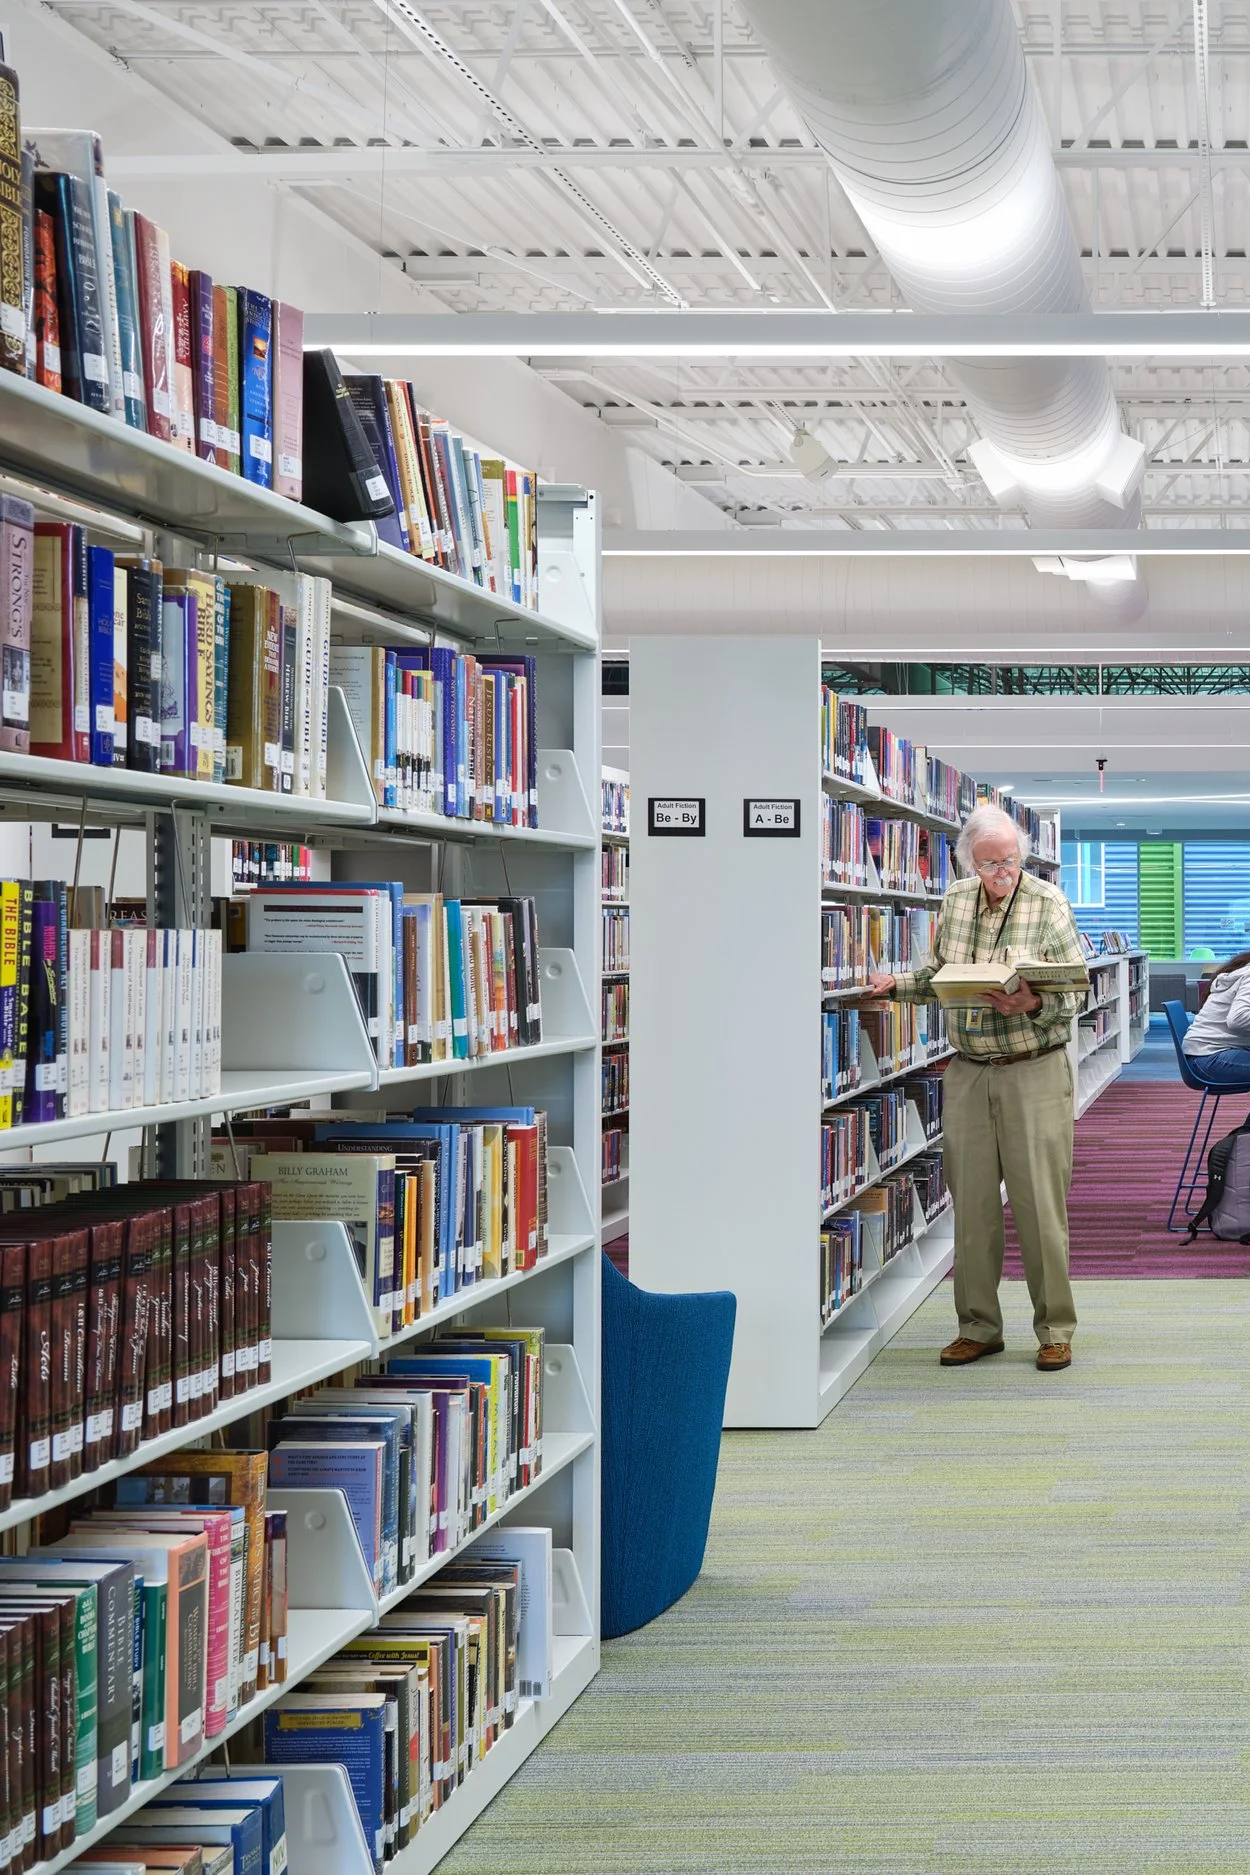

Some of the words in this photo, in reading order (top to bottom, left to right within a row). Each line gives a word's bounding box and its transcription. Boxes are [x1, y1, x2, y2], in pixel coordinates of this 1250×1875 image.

[1, 162, 21, 186] OLY
[11, 534, 26, 638] STRONG'S
[205, 592, 213, 646] HARD
[204, 649, 213, 723] SAYINGS
[656, 813, 671, 822] Be
[682, 813, 697, 824] By
[755, 814, 764, 823] A
[774, 814, 790, 824] Be
[5, 899, 17, 922] THE
[22, 890, 33, 967] BIBLE
[4, 928, 16, 966] BIBLE
[43, 926, 56, 960] NUMBER
[337, 1143, 392, 1151] UNDERSTANDING
[278, 1166, 303, 1176] BILLY
[306, 1166, 348, 1177] GRAHAM
[150, 1296, 159, 1335] Genesis
[161, 1292, 169, 1336] Numbers
[178, 1272, 189, 1342] Deuteronomy
[40, 1331, 51, 1382] Acts
[63, 1329, 71, 1381] Romans
[77, 1329, 85, 1392] Corinthians
[255, 1503, 265, 1558] WHO'S
[252, 1561, 263, 1605] WHO
[107, 1586, 116, 1704] COMMENTARY
[117, 1615, 126, 1665] BIBLE
[232, 1629, 240, 1666] LITER
[368, 1652, 385, 1660] Coffee
[400, 1652, 420, 1660] Jesus!
